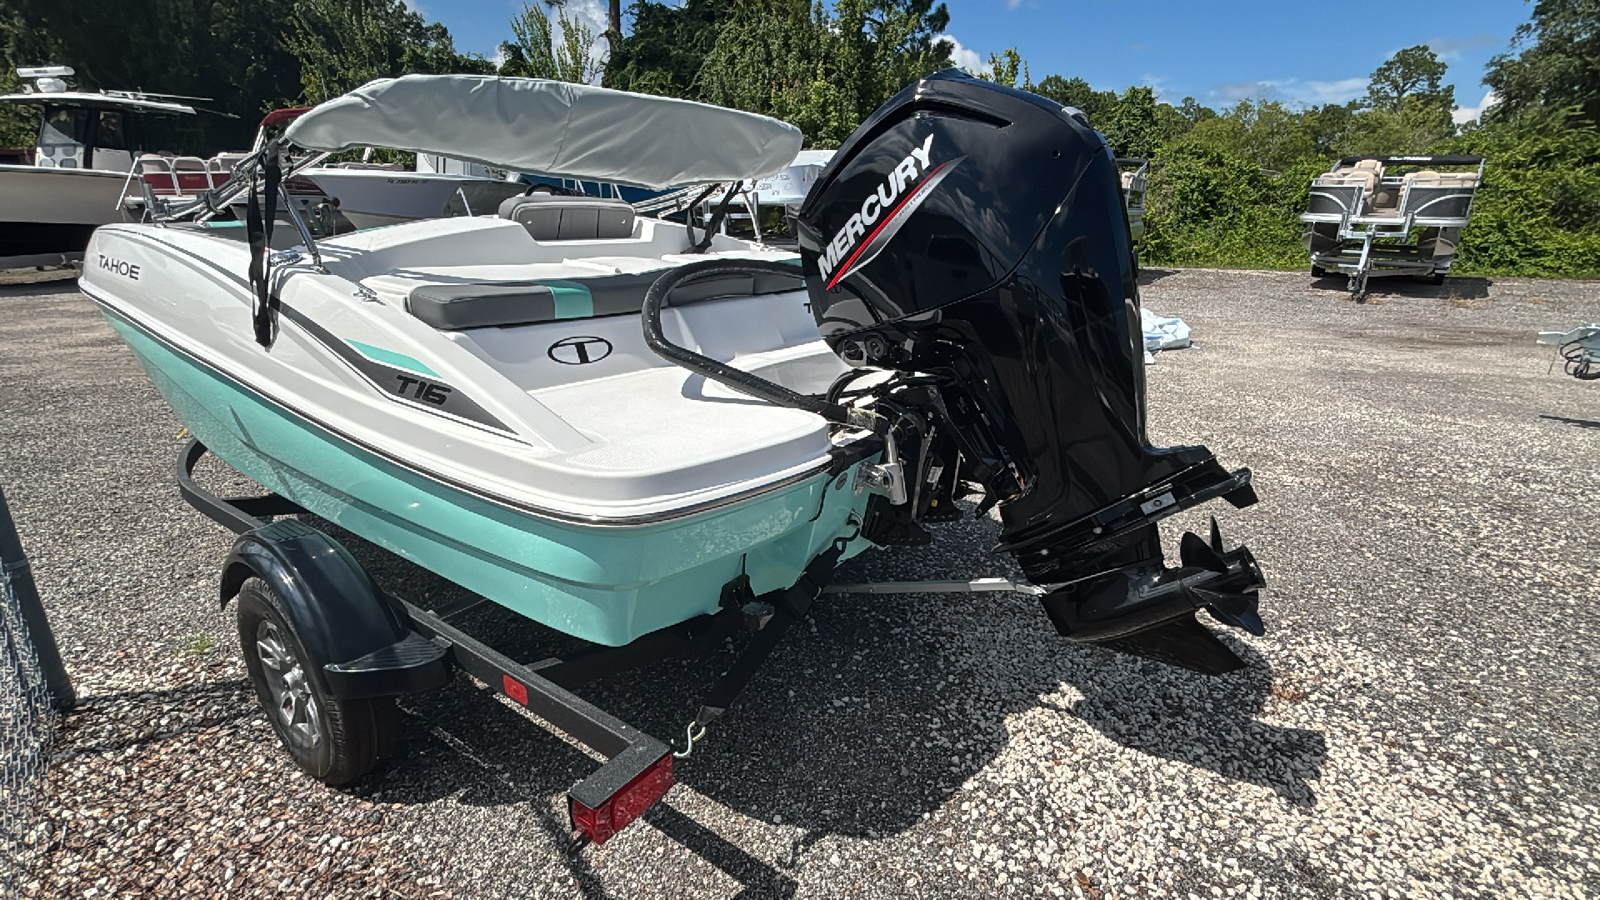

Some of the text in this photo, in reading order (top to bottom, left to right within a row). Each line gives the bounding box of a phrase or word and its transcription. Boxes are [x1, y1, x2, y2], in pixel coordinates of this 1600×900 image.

[817, 133, 934, 282] MERCURY
[99, 254, 141, 280] TAHOE
[396, 375, 452, 405] T16
